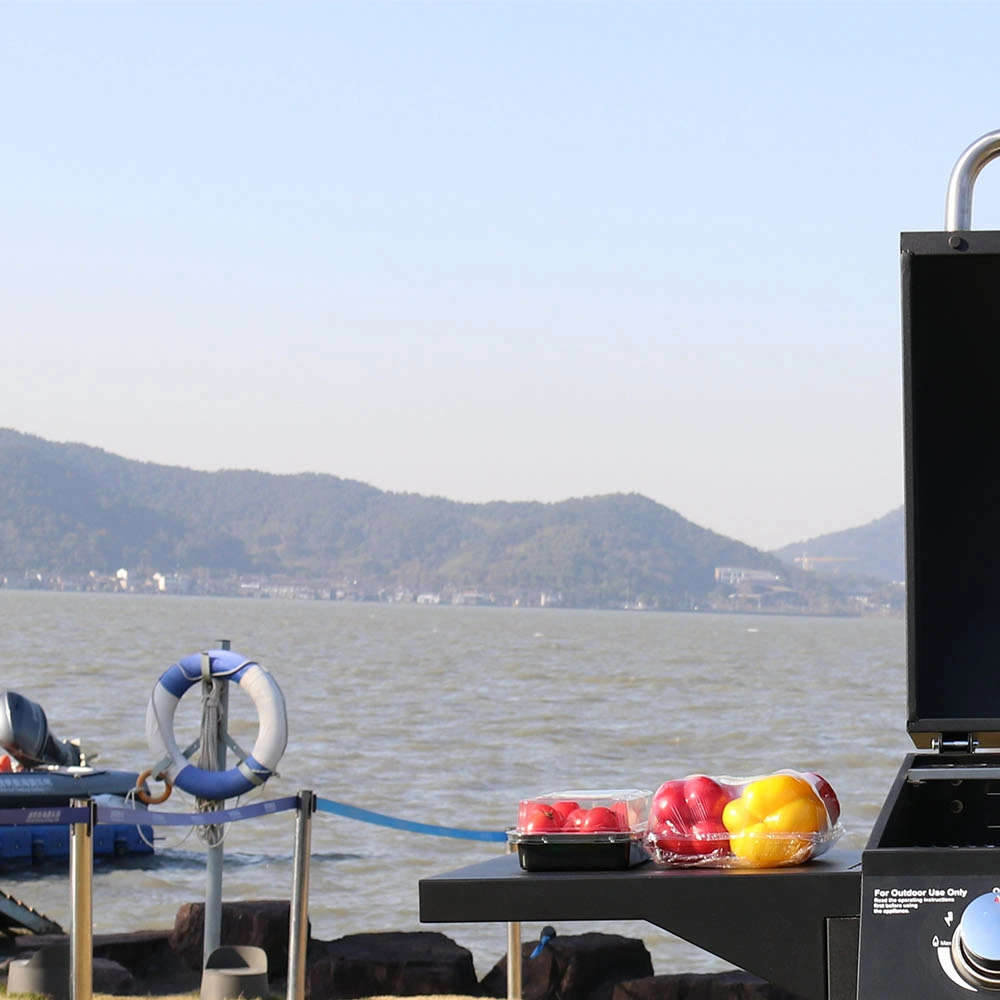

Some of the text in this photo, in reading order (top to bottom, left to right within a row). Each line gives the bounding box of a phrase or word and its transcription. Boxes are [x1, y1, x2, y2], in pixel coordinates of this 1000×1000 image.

[874, 888, 967, 898] For Outdoor Use Only
